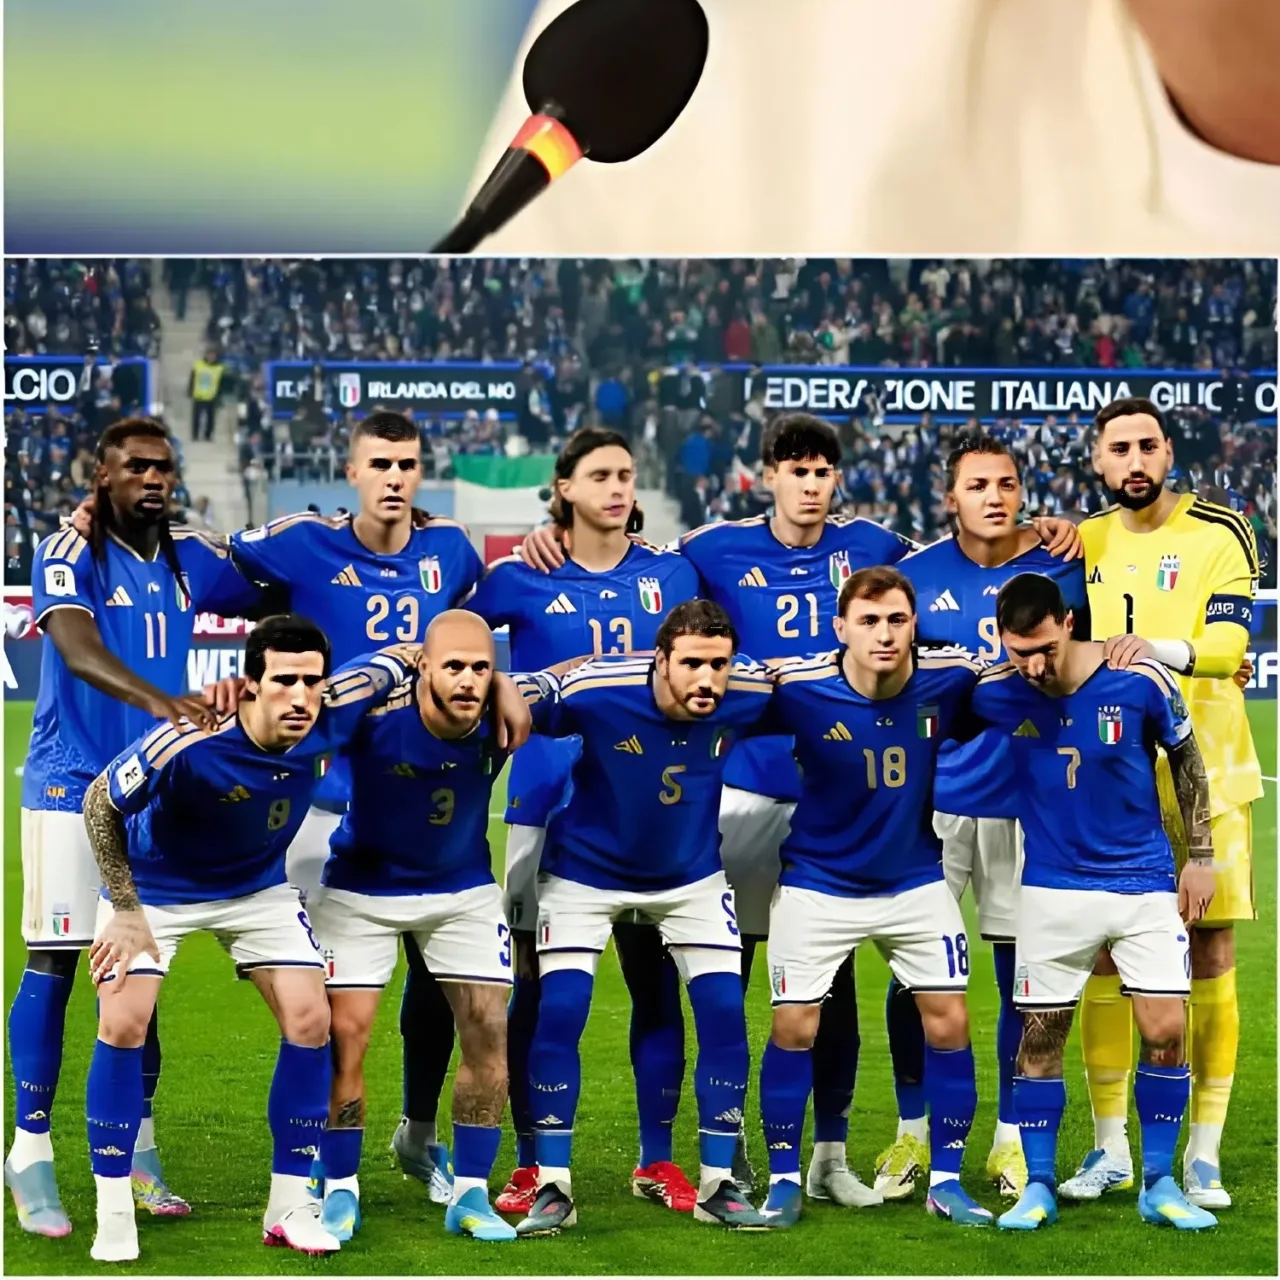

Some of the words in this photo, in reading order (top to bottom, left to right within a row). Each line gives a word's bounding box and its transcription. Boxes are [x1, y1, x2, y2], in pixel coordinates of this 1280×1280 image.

[366, 595, 419, 641] 23
[776, 593, 823, 638] 21
[1123, 593, 1134, 634] 1
[145, 612, 166, 658] 11
[588, 617, 632, 655] 13
[978, 617, 1001, 660] 9
[659, 765, 687, 805] 5
[863, 746, 906, 789] 18
[1057, 747, 1081, 789] 7
[267, 798, 290, 830] 8
[428, 788, 455, 825] 3
[942, 932, 968, 978] 18
